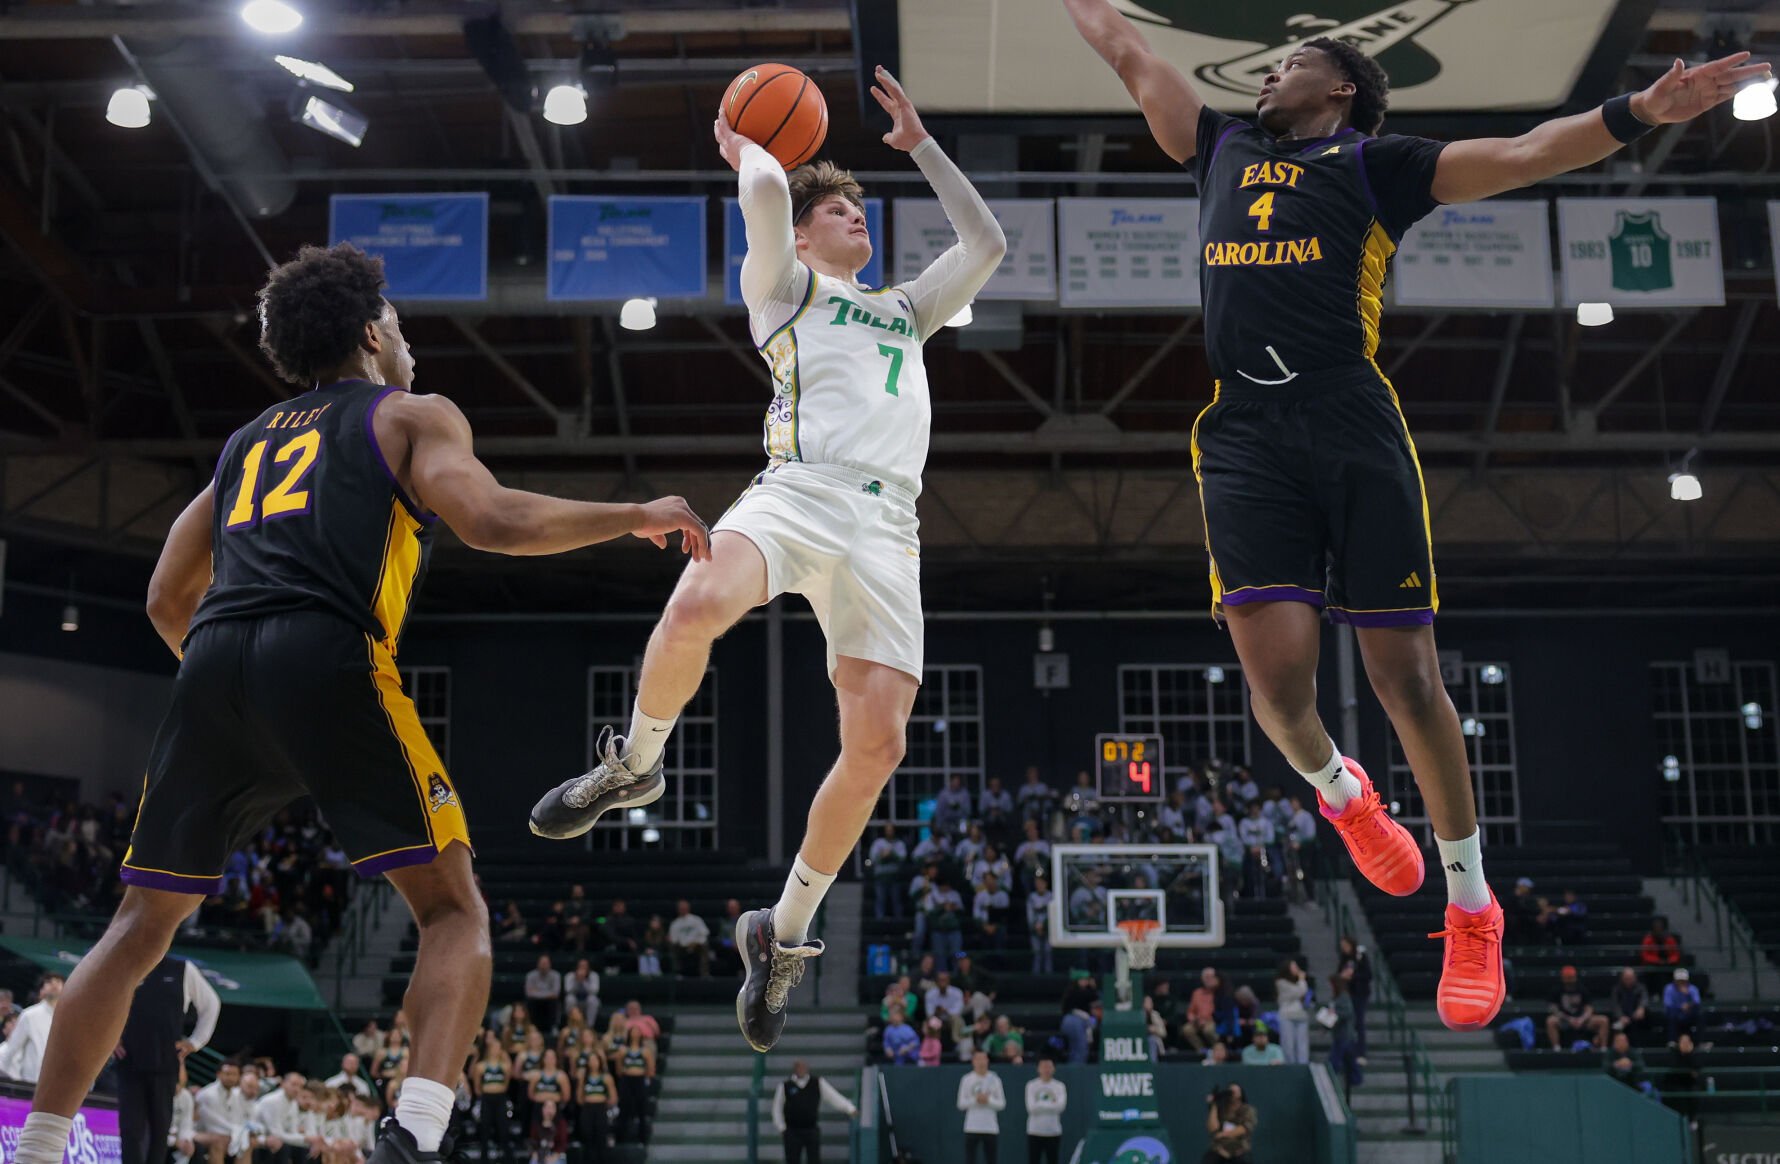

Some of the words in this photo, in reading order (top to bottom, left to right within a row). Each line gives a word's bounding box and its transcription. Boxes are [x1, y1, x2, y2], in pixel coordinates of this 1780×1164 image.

[1238, 161, 1304, 188] EAST
[1248, 191, 1275, 231] 4
[1205, 237, 1323, 266] CAROLINA
[1630, 244, 1653, 268] 10
[828, 296, 919, 341] TULA
[877, 343, 904, 397] 7
[266, 402, 332, 429] RILEY
[226, 428, 322, 531] 12
[1129, 762, 1151, 793] 4
[1104, 1038, 1148, 1061] ROLL
[1101, 1073, 1154, 1097] WAVE
